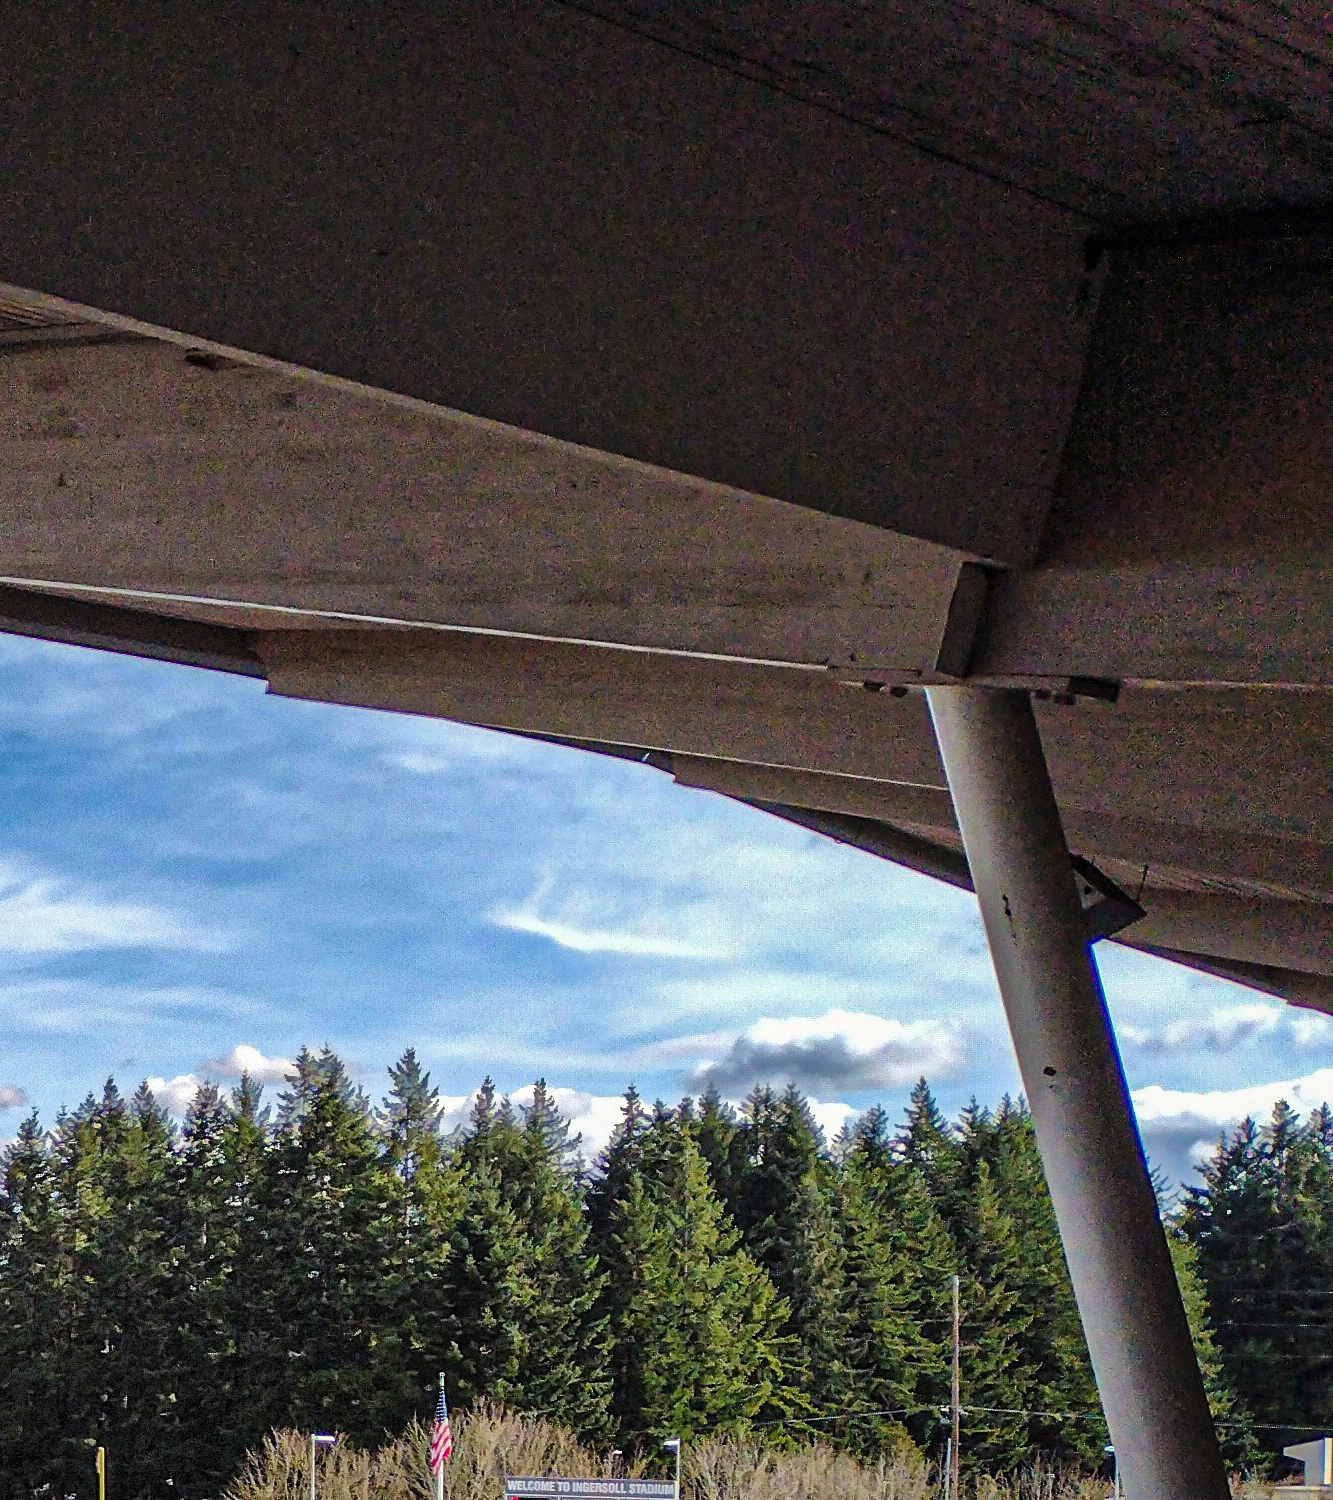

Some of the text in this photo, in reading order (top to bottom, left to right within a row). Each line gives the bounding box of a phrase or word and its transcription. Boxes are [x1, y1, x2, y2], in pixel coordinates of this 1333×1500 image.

[507, 1480, 674, 1495] WELCOME TO INGERSOLL STADIUM
